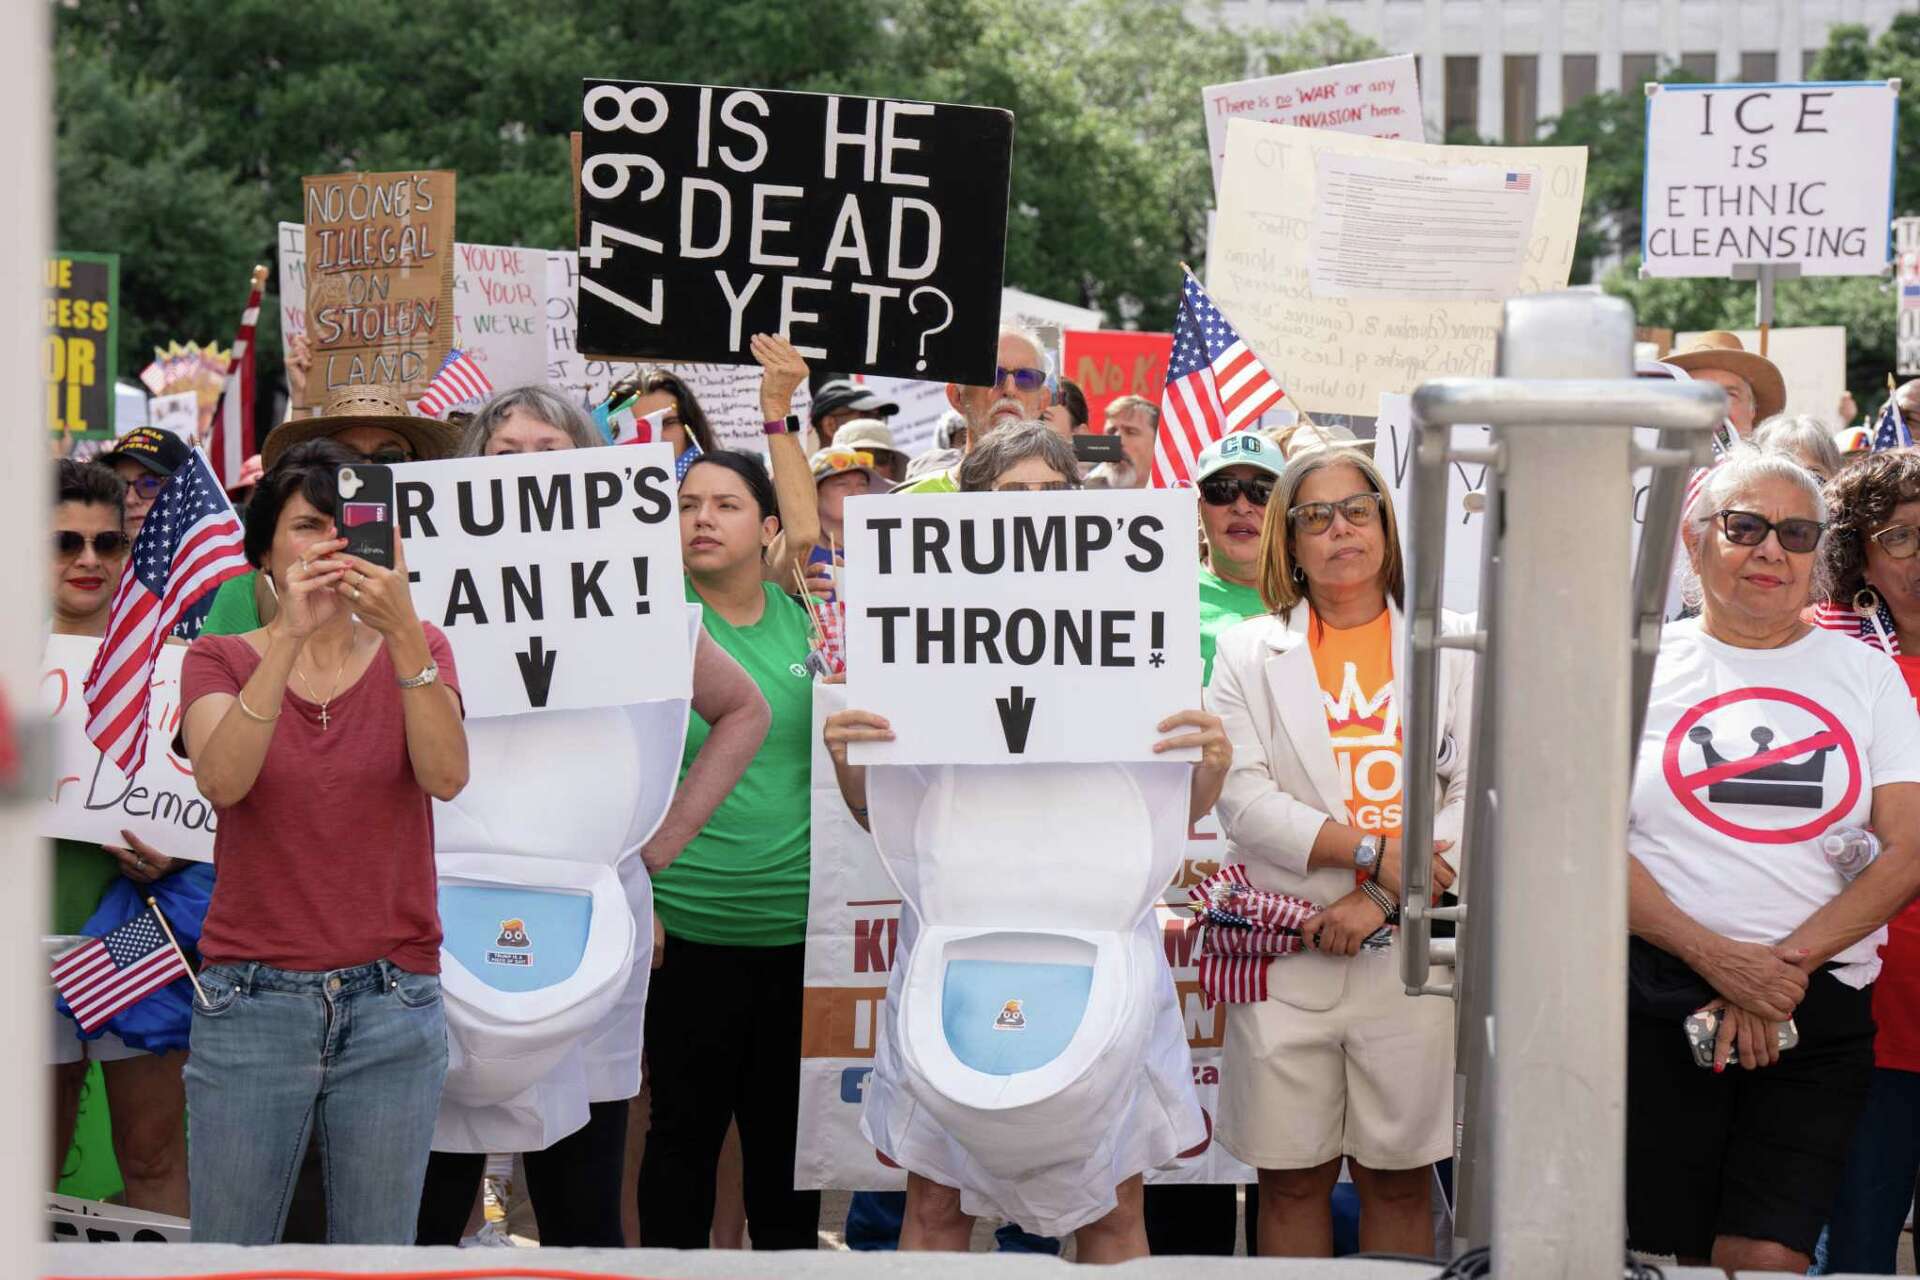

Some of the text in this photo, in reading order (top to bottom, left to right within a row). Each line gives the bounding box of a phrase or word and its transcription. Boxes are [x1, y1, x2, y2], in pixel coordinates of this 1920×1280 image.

[1214, 96, 1254, 115] There
[1258, 97, 1269, 108] is
[1275, 94, 1293, 106] no
[1344, 83, 1361, 95] or
[1368, 79, 1396, 96] any
[1700, 91, 1834, 136] ICE
[697, 87, 936, 188] IS HE
[1731, 144, 1769, 168] IS
[579, 85, 669, 325] 8647
[1667, 181, 1827, 217] ETHNIC
[316, 223, 435, 269] ILLEGAL
[680, 177, 942, 281] DEAD
[1648, 225, 1867, 258] CLEANSING
[460, 245, 527, 276] YOU'RE
[349, 274, 390, 304] ON
[479, 276, 537, 306] YOUR
[317, 297, 437, 343] STOLEN
[473, 314, 535, 335] WE'RE
[715, 270, 954, 372] YET?
[326, 351, 425, 391] LAND
[1077, 354, 1124, 396] No
[395, 466, 672, 539] RUMP'S
[866, 515, 1165, 575] TRUMP'S
[408, 556, 651, 627] ANK!
